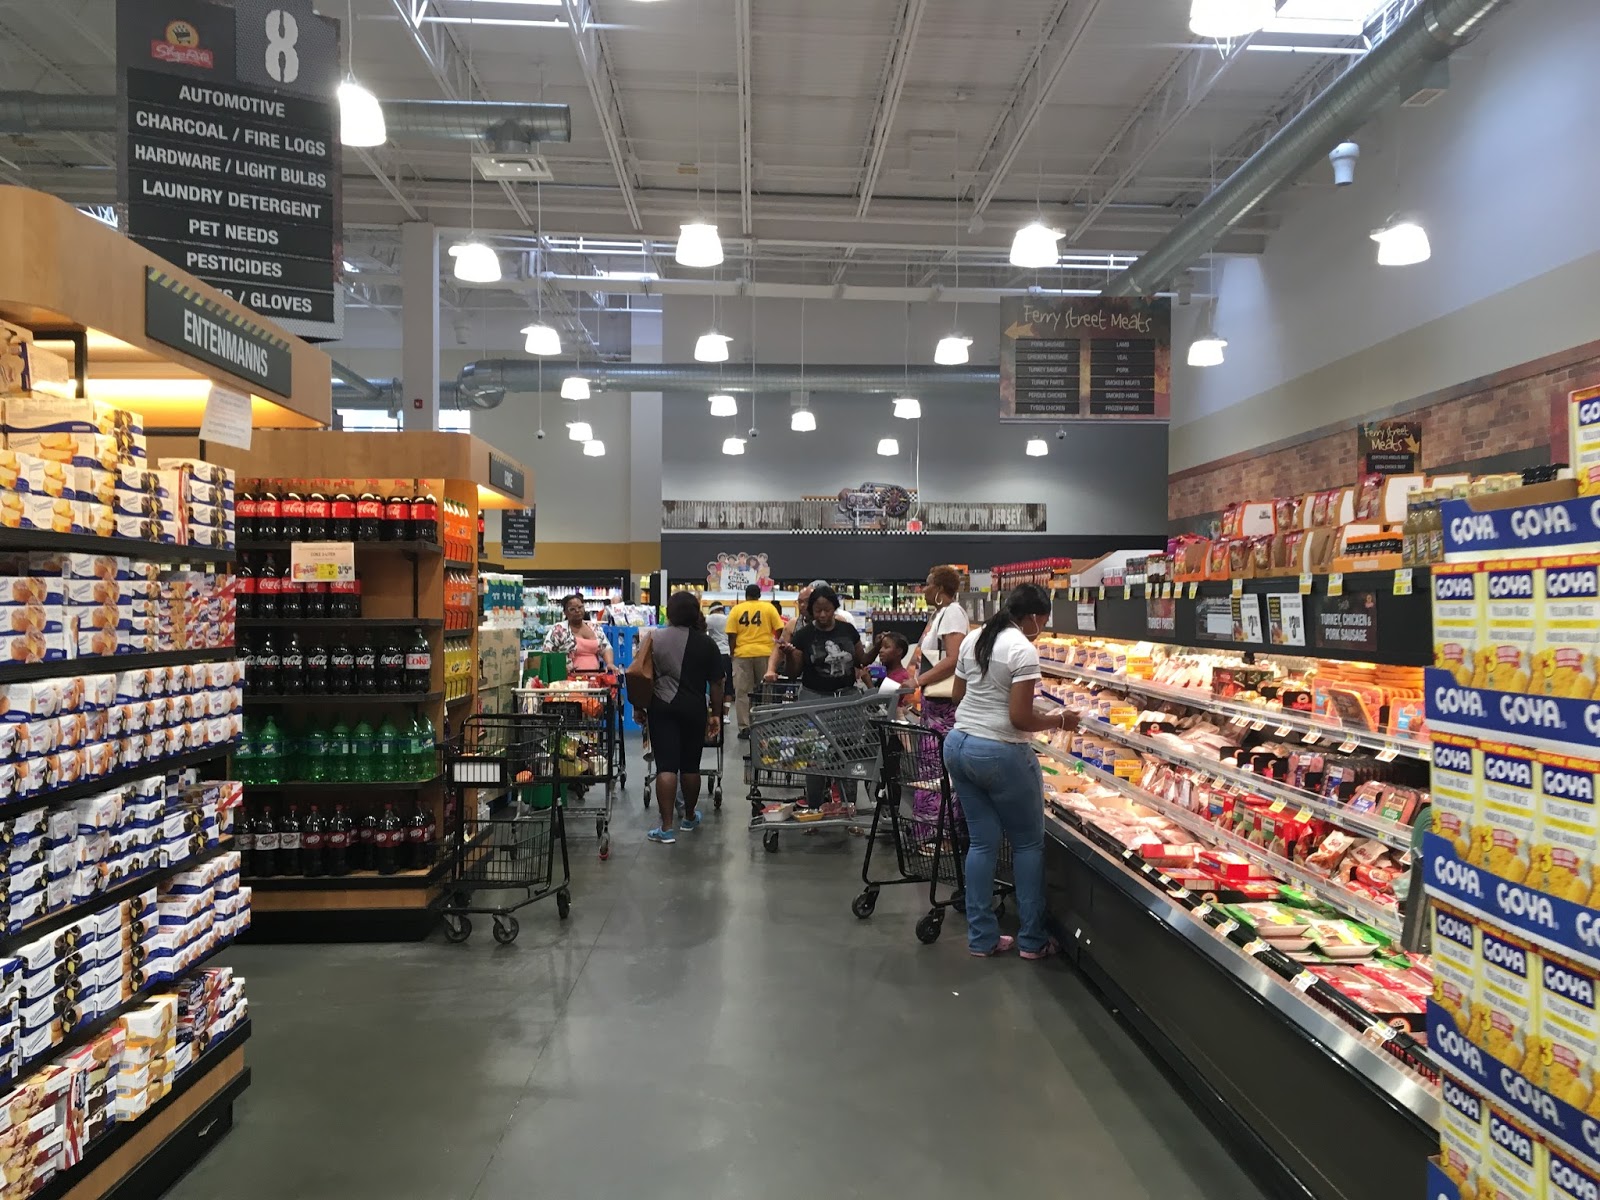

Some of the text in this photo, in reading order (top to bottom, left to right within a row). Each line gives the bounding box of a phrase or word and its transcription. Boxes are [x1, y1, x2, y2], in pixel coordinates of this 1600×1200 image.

[265, 9, 299, 83] 8
[179, 85, 285, 118] AUTOMOTIVE
[136, 110, 326, 156] CHARCOAL / FIRE LOGS
[135, 144, 326, 188] HARDWARE / LIGHT BULBS
[142, 179, 321, 219] LAUNDRY DETERGENT
[189, 219, 279, 245] PET NEEDS
[186, 252, 282, 277] PESTICIDES
[250, 292, 312, 313] GLOVES
[1024, 305, 1061, 330] Ferry
[1111, 312, 1152, 332] Meats
[184, 309, 268, 378] ENTENMANNS
[1371, 436, 1402, 452] Meats
[928, 508, 1022, 524] NEWARK NEW JERSEY
[1451, 514, 1495, 544] GOYA
[1510, 505, 1572, 540] GOYA
[1436, 570, 1597, 599] GOYA GOYA GOYA
[739, 611, 761, 626] 44
[1326, 628, 1367, 641] PORK SAUSAGE
[1343, 614, 1367, 626] CHICKEN
[407, 655, 428, 666] Coke
[1435, 686, 1484, 718] GOYA
[1500, 695, 1561, 729] GOYA
[1435, 746, 1593, 799] GOYA GOYA GOYA
[1434, 856, 1554, 928] GOYA GOYA
[1438, 914, 1592, 1004] GOYA GOYA GOYA
[1436, 1023, 1560, 1126] GOYA GOYA
[1443, 1081, 1598, 1200] GOYA GOYA GOYA
